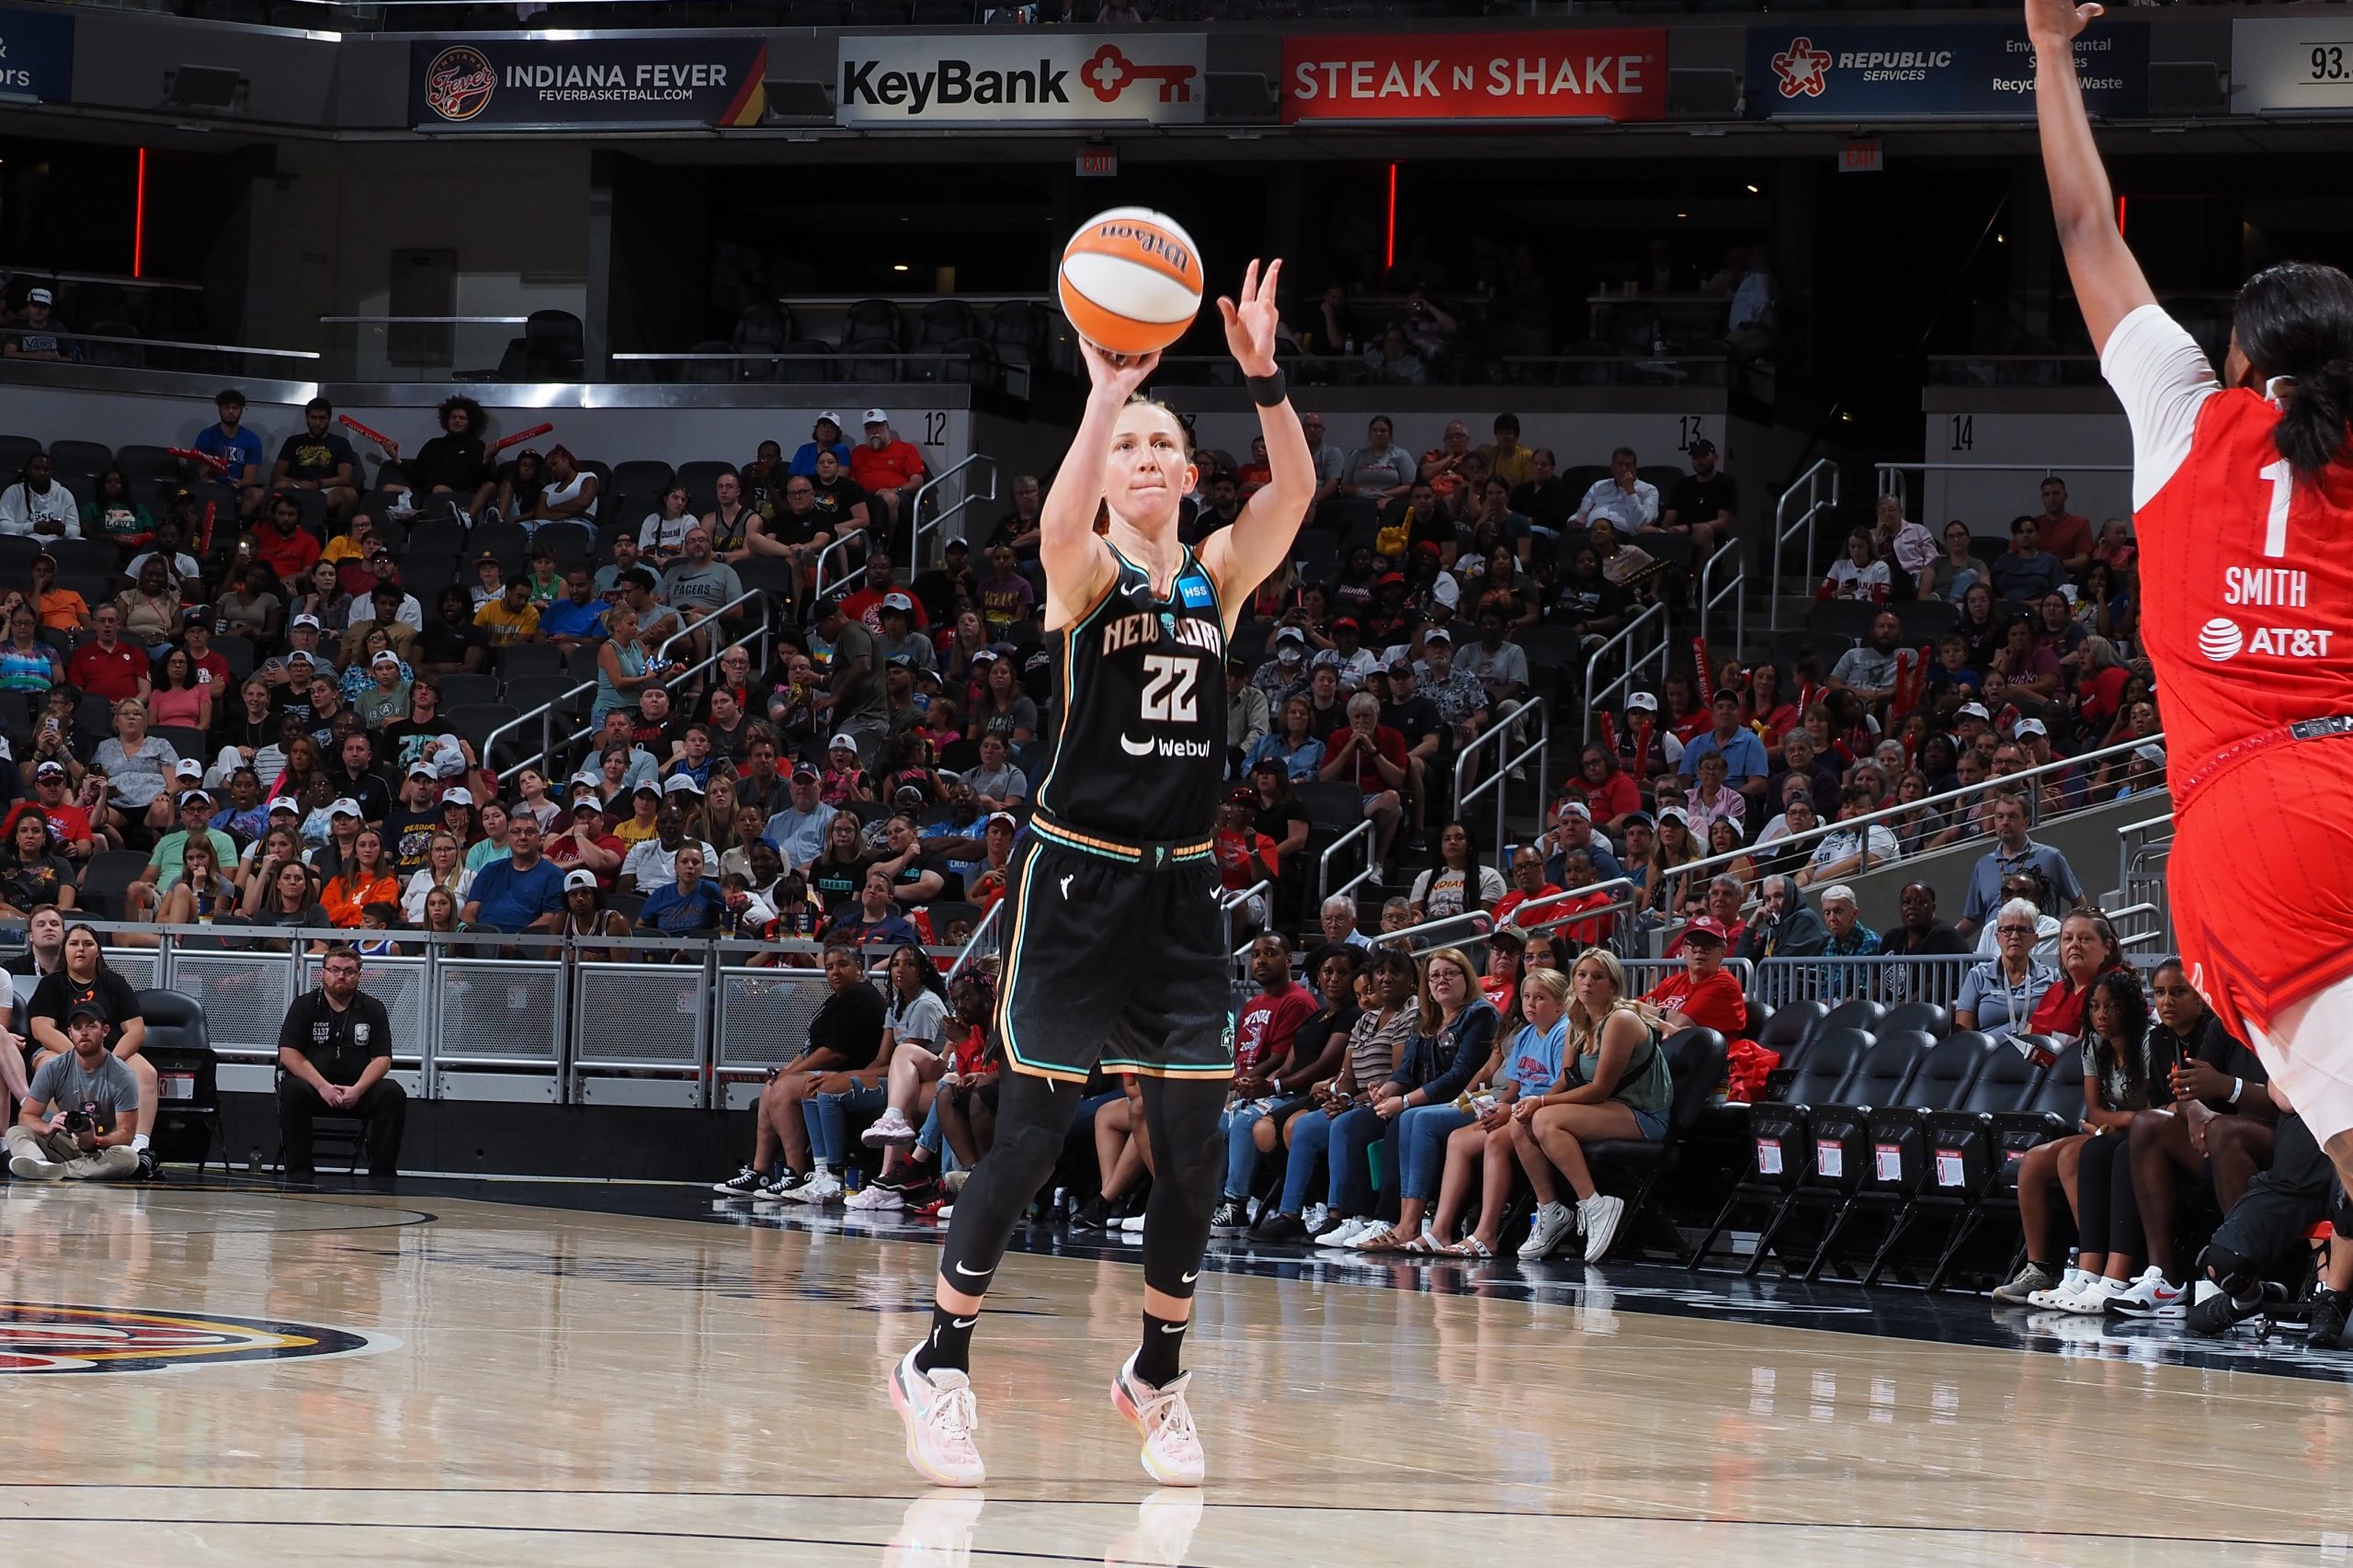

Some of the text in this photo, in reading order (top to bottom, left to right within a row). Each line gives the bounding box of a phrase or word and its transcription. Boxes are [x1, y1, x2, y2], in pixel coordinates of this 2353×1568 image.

[438, 53, 482, 72] INDIANA
[1839, 51, 1952, 68] REPUBLIC
[428, 65, 495, 106] Fever
[506, 64, 727, 87] INDIANA FEVER
[843, 58, 1070, 114] KeyBank
[1294, 56, 1643, 100] STEAK N SHAKE
[1863, 69, 1926, 81] SERVICES
[2079, 76, 2123, 89] Waste
[539, 89, 692, 101] FEVERBASKETBALL.COM
[1084, 149, 1112, 172] EXIT
[1847, 146, 1876, 166] EXIT
[1099, 223, 1188, 274] Wilson
[924, 411, 946, 446] 12
[1677, 415, 1701, 451] 13
[1951, 415, 1973, 450] 14
[2259, 458, 2293, 558] 1
[673, 584, 710, 596] PACERS
[1184, 585, 1208, 598] HSS
[2223, 566, 2307, 608] SMITH
[1102, 612, 1160, 658] NEW
[2248, 627, 2334, 657] AT&T
[1695, 653, 1705, 676] MAKE
[1141, 653, 1199, 722] 22
[1242, 1009, 1272, 1028] WNBA
[313, 1028, 330, 1036] 5137
